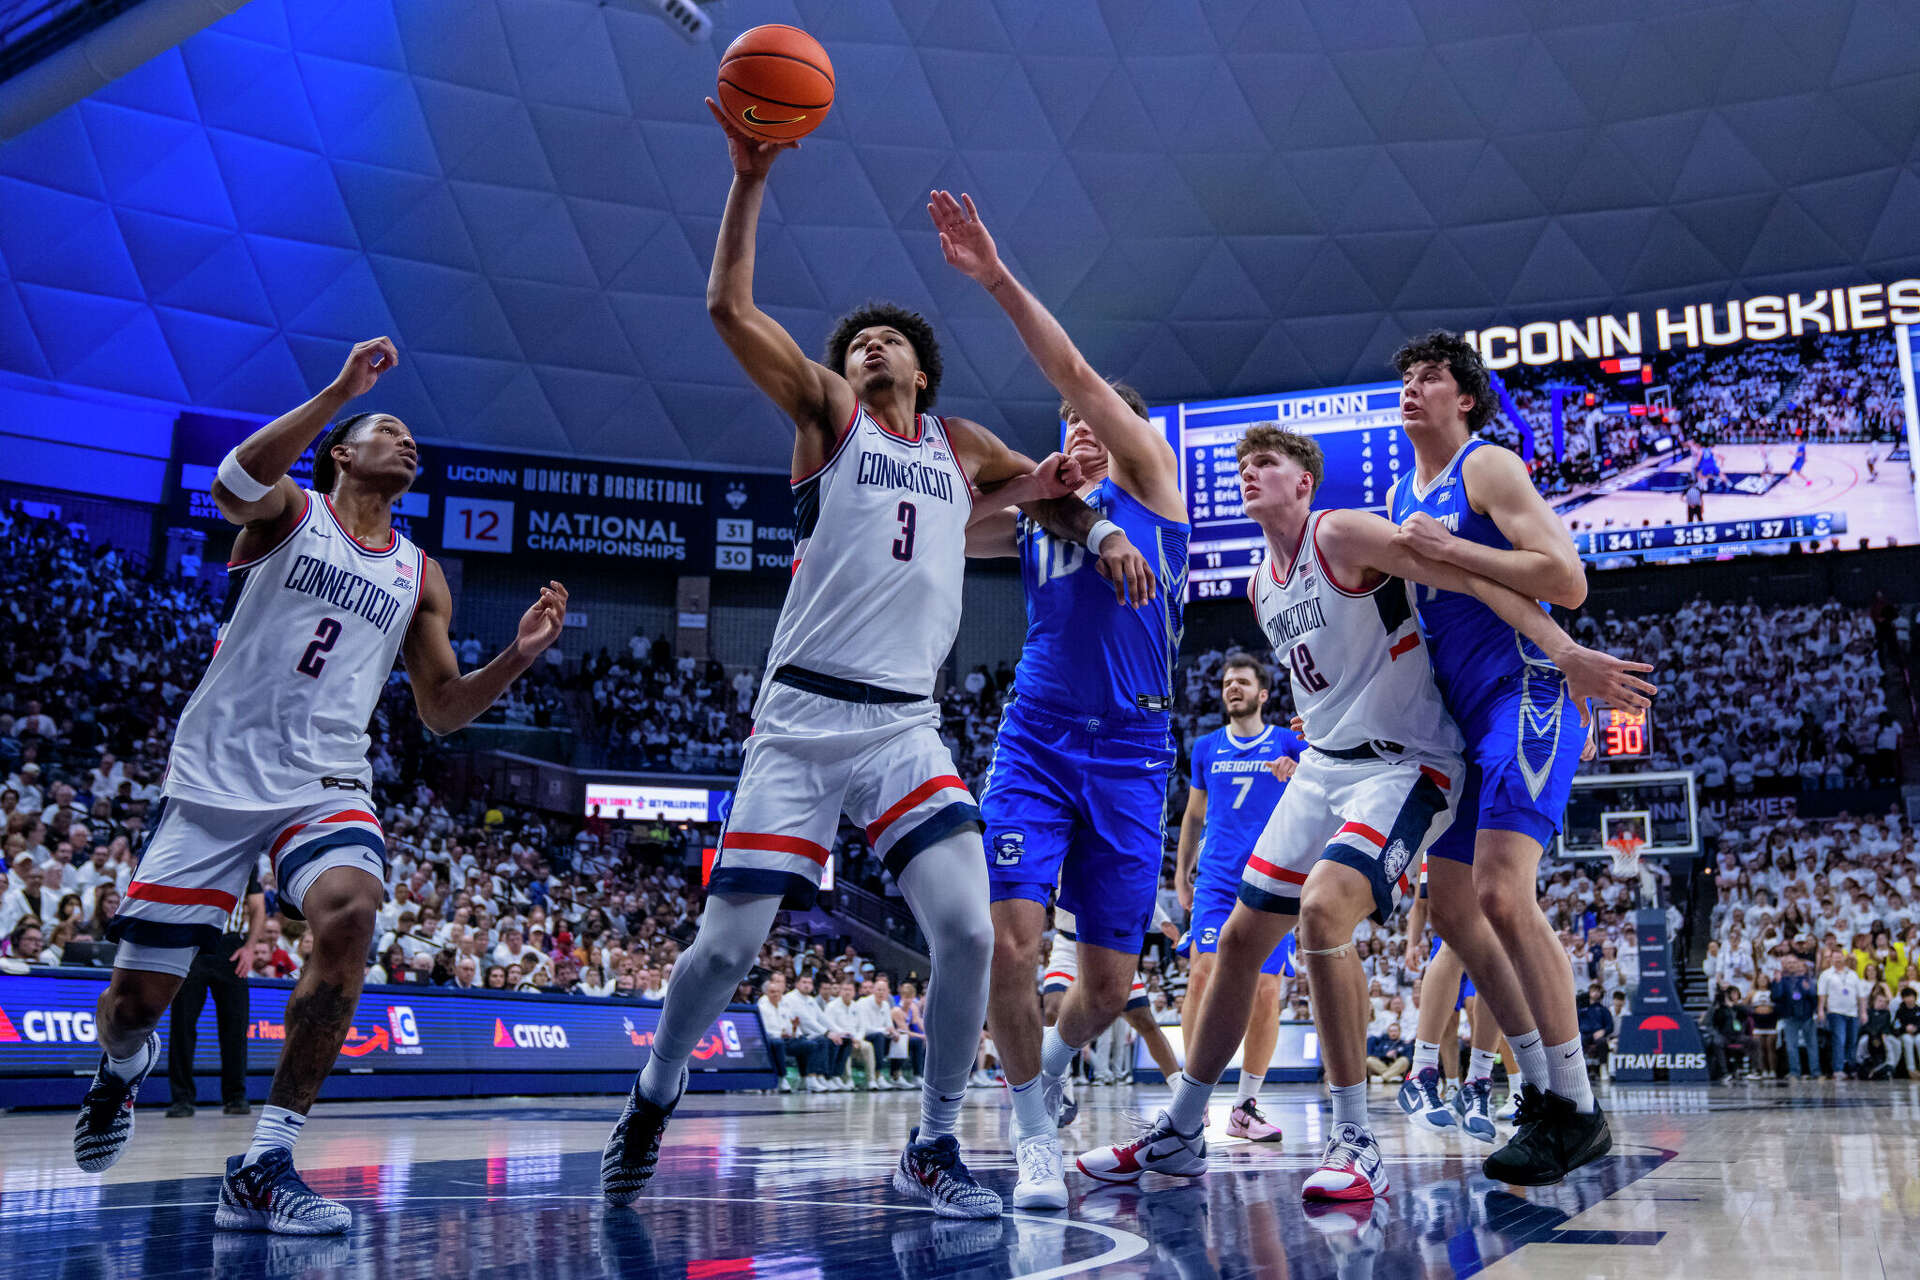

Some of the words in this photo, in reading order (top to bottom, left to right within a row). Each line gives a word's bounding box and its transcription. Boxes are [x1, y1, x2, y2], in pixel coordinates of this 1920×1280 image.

[1656, 278, 1920, 351] HUSKIES
[1278, 394, 1368, 421] UCONN
[1362, 432, 1371, 444] 3
[1389, 429, 1397, 441] 2
[447, 465, 517, 485] UCONN
[524, 468, 598, 496] WOMEN'S
[604, 474, 704, 506] BASKETBALL
[857, 451, 953, 505] CONNECTICUT
[1193, 506, 1209, 519] 24
[1364, 491, 1374, 503] 2
[1194, 491, 1208, 504] 12
[460, 509, 500, 541] 12
[529, 510, 686, 544] NATIONAL
[727, 523, 744, 538] 31
[892, 501, 917, 562] 3
[1609, 532, 1633, 550] 34
[1674, 526, 1717, 545] 3:53
[1761, 521, 1784, 537] 37
[527, 533, 686, 561] CHAMPIONSHIPS
[722, 551, 746, 566] 30
[1206, 552, 1221, 568] 11
[285, 554, 401, 635] CONNECTICUT
[1198, 580, 1232, 597] 51.9
[1266, 597, 1327, 648] CONNECTICUT
[296, 617, 343, 679] 2
[1289, 642, 1329, 694] 12
[1607, 725, 1643, 755] 30
[1210, 760, 1274, 774] CREIGHTO
[1231, 776, 1254, 810] 7
[23, 1011, 97, 1042] CITG
[513, 1024, 568, 1049] CITGO
[1617, 1053, 1706, 1069] TRAVELERS
